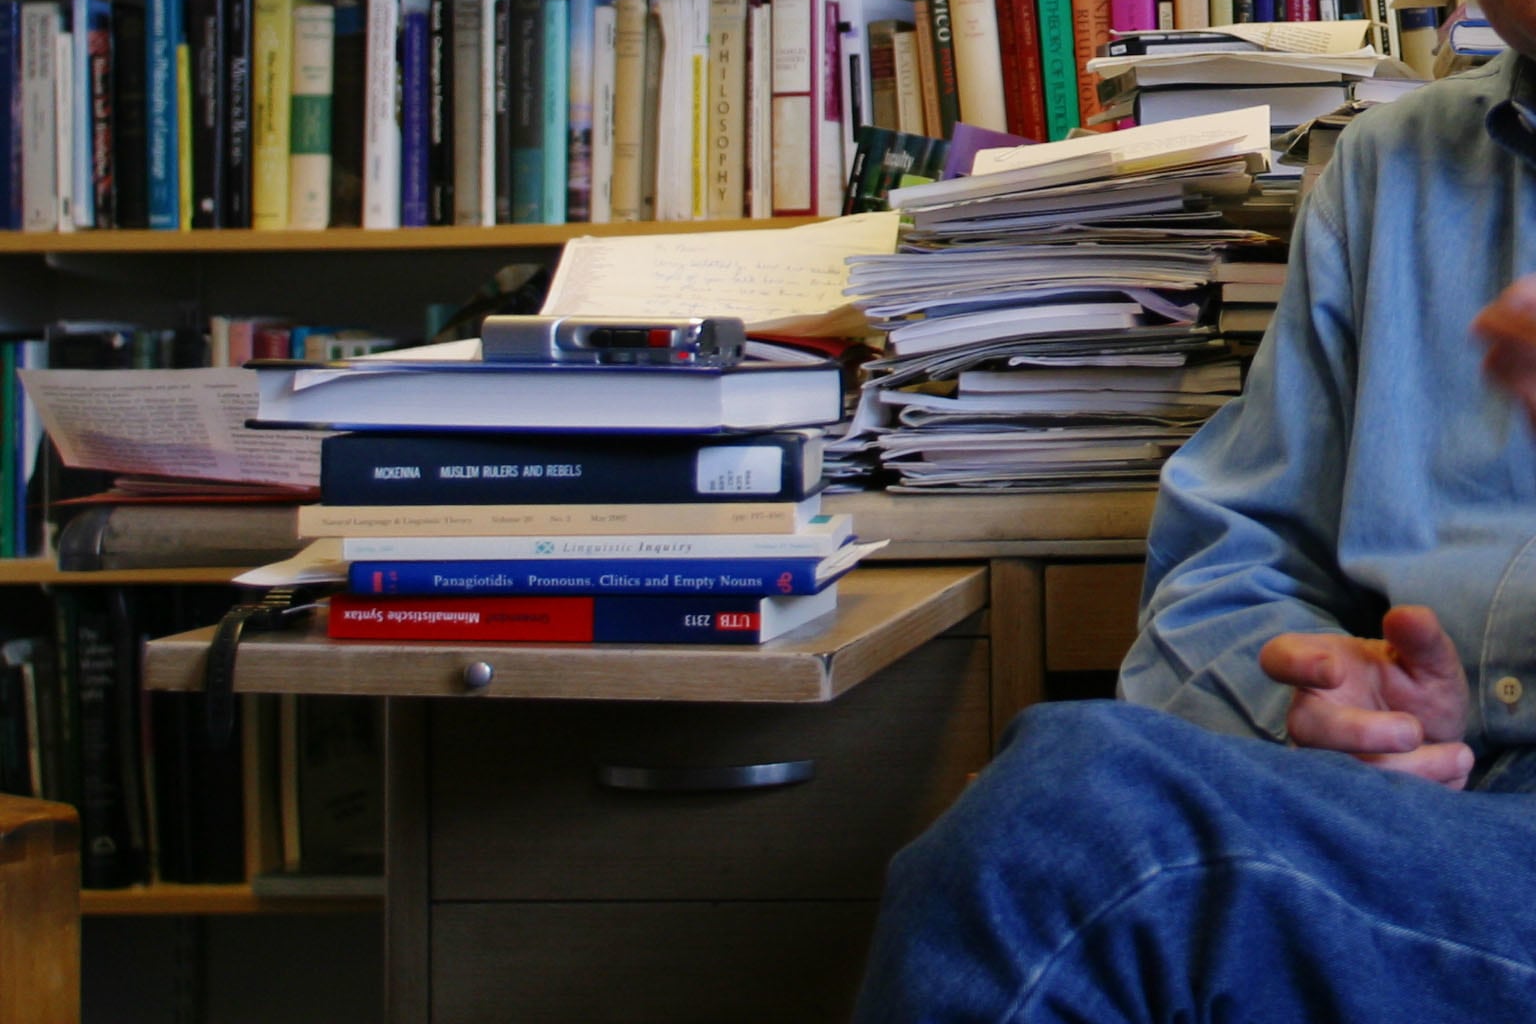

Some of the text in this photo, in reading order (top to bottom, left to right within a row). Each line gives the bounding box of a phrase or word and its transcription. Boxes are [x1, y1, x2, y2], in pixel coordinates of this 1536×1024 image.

[1050, 58, 1065, 79] OF
[1051, 80, 1069, 136] JUSTICE
[718, 32, 732, 200] PHILOSOPHY
[374, 464, 582, 479] MCKENNA MUSLIM RULERS AND REBELS
[354, 518, 391, 528] Language
[404, 518, 440, 528] Linguistic
[444, 517, 472, 527] Theory
[563, 542, 692, 555] Linguistic Inquiry
[434, 575, 513, 590] Panagiotidis
[600, 575, 640, 587] Clitics
[645, 576, 670, 587] and
[674, 575, 714, 590] Empty
[720, 575, 762, 587] Nouns
[344, 610, 383, 622] Syntax
[386, 610, 480, 623] Minimalistische
[684, 614, 749, 628] UTB 2313
